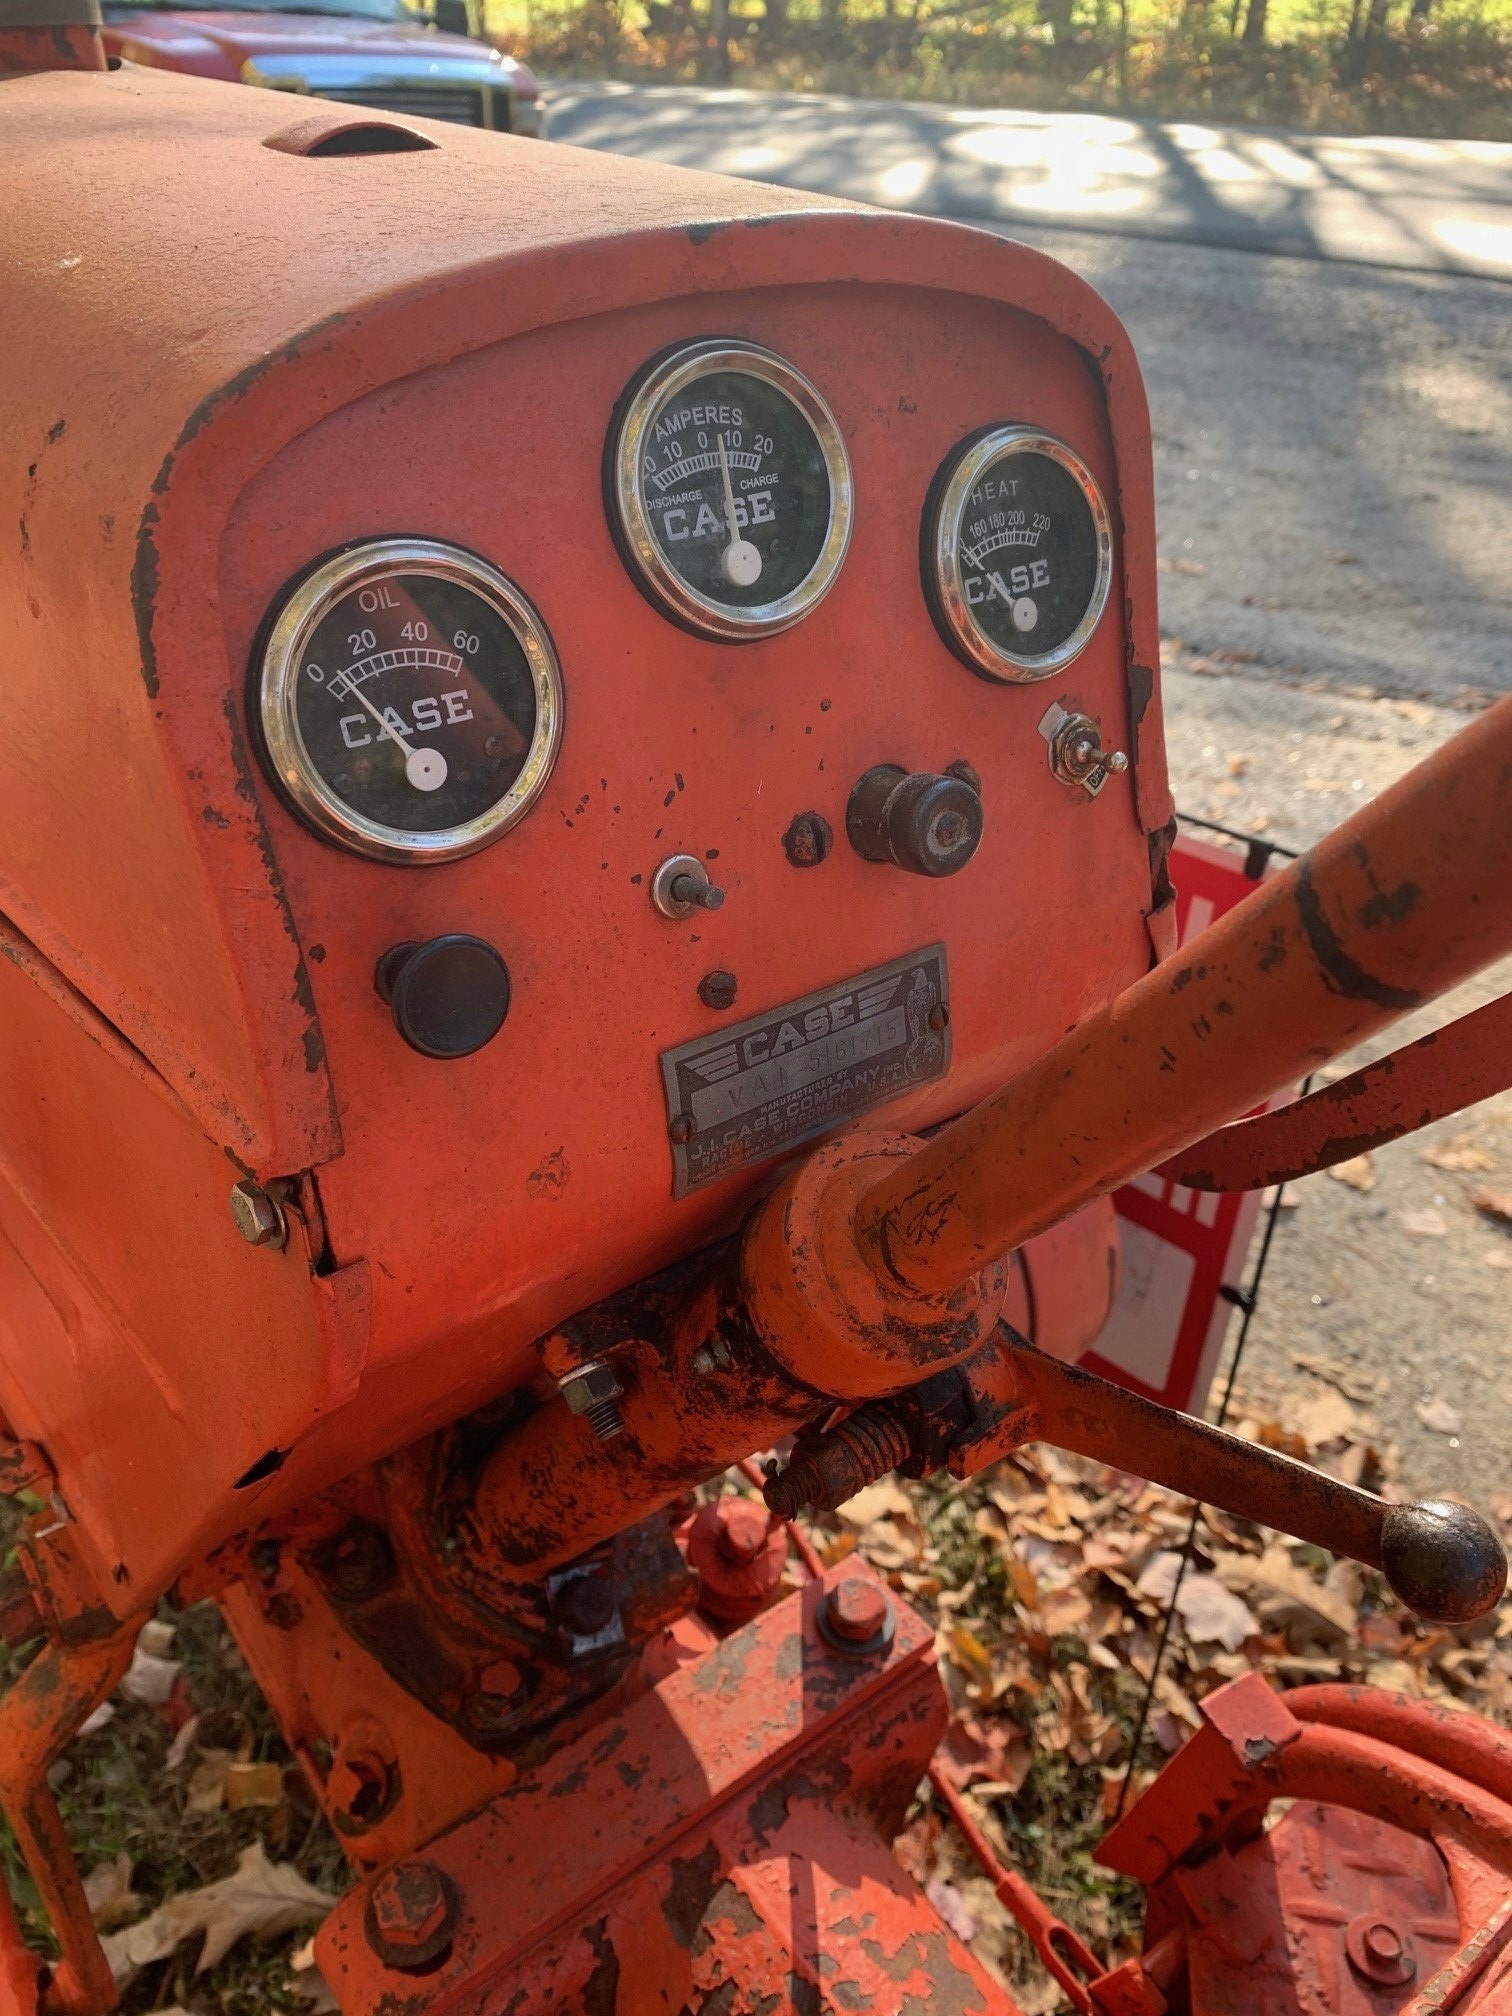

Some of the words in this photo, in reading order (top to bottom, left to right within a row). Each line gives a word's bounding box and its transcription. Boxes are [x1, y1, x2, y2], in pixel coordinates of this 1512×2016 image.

[655, 406, 742, 442] AMPERES
[663, 441, 682, 462] 10
[697, 431, 708, 449] 0
[724, 430, 742, 448] 10
[754, 434, 773, 454] 20
[740, 473, 779, 490] CHARGE
[972, 480, 1018, 505] HEAT
[663, 490, 776, 541] CASE
[970, 519, 987, 538] 160
[988, 512, 1005, 529] 180
[1007, 510, 1025, 526] 200
[1033, 512, 1051, 531] 220
[358, 586, 400, 613] OIL
[964, 559, 1051, 605] CASE
[306, 663, 325, 683] 0
[347, 629, 377, 656] 20
[400, 621, 428, 641] 40
[453, 629, 479, 655] 60
[339, 689, 474, 749] CASE
[743, 996, 855, 1066] CASE
[723, 1110, 780, 1146] CASE
[786, 1065, 880, 1117] COMPANY
[760, 1077, 833, 1115] MANUFACTURED
[836, 1069, 849, 1081] BY
